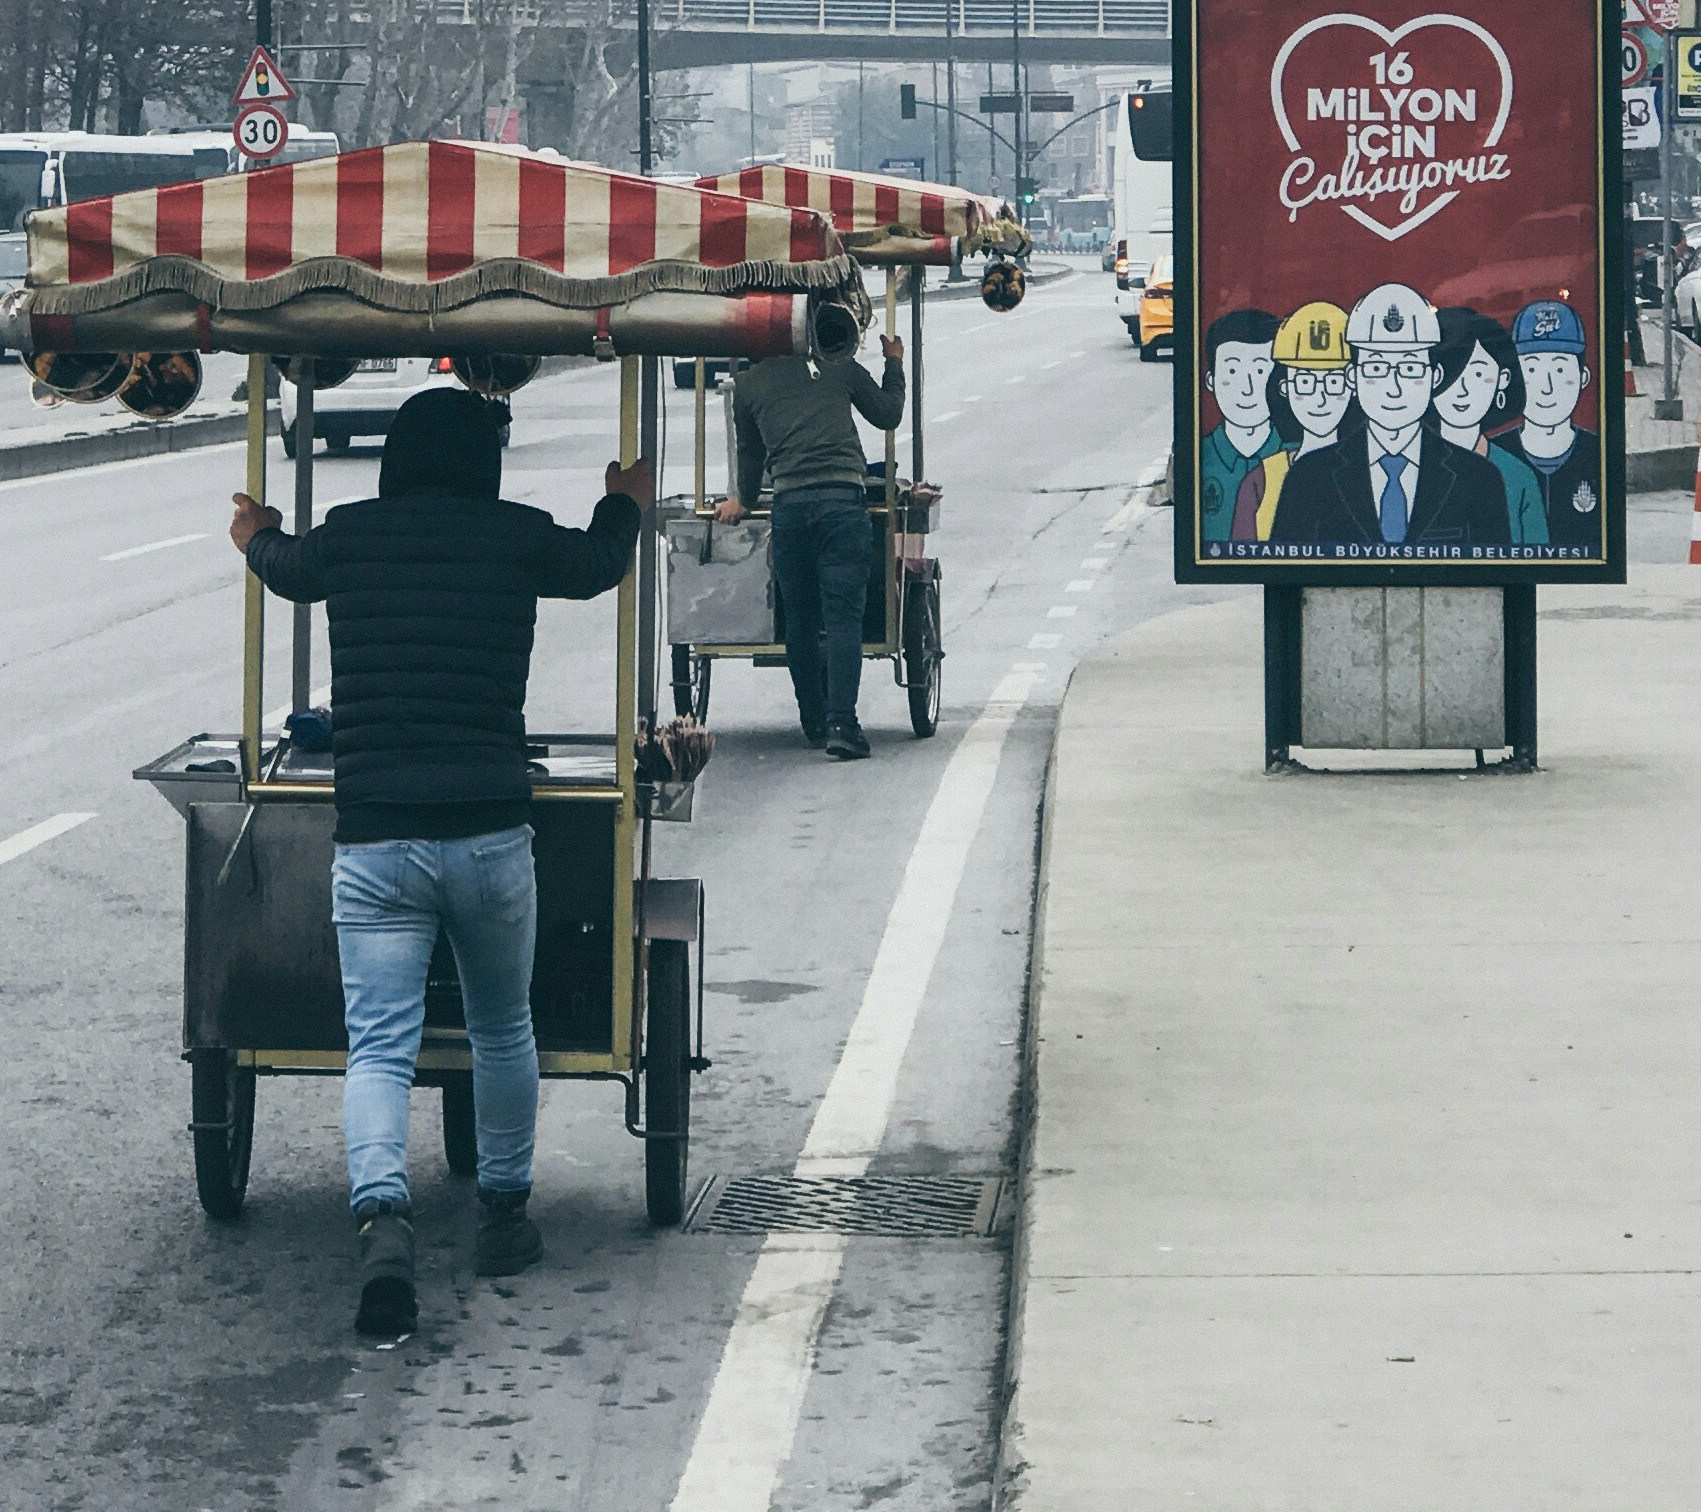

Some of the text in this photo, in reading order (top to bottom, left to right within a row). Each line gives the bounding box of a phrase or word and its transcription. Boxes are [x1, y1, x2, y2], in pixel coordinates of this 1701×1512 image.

[1368, 51, 1414, 85] 16
[244, 119, 278, 144] 30
[1278, 149, 1512, 223] Çalışıyoruz
[1228, 542, 1325, 557] İSTANBUL
[1472, 544, 1589, 559] BELEDİYESİ
